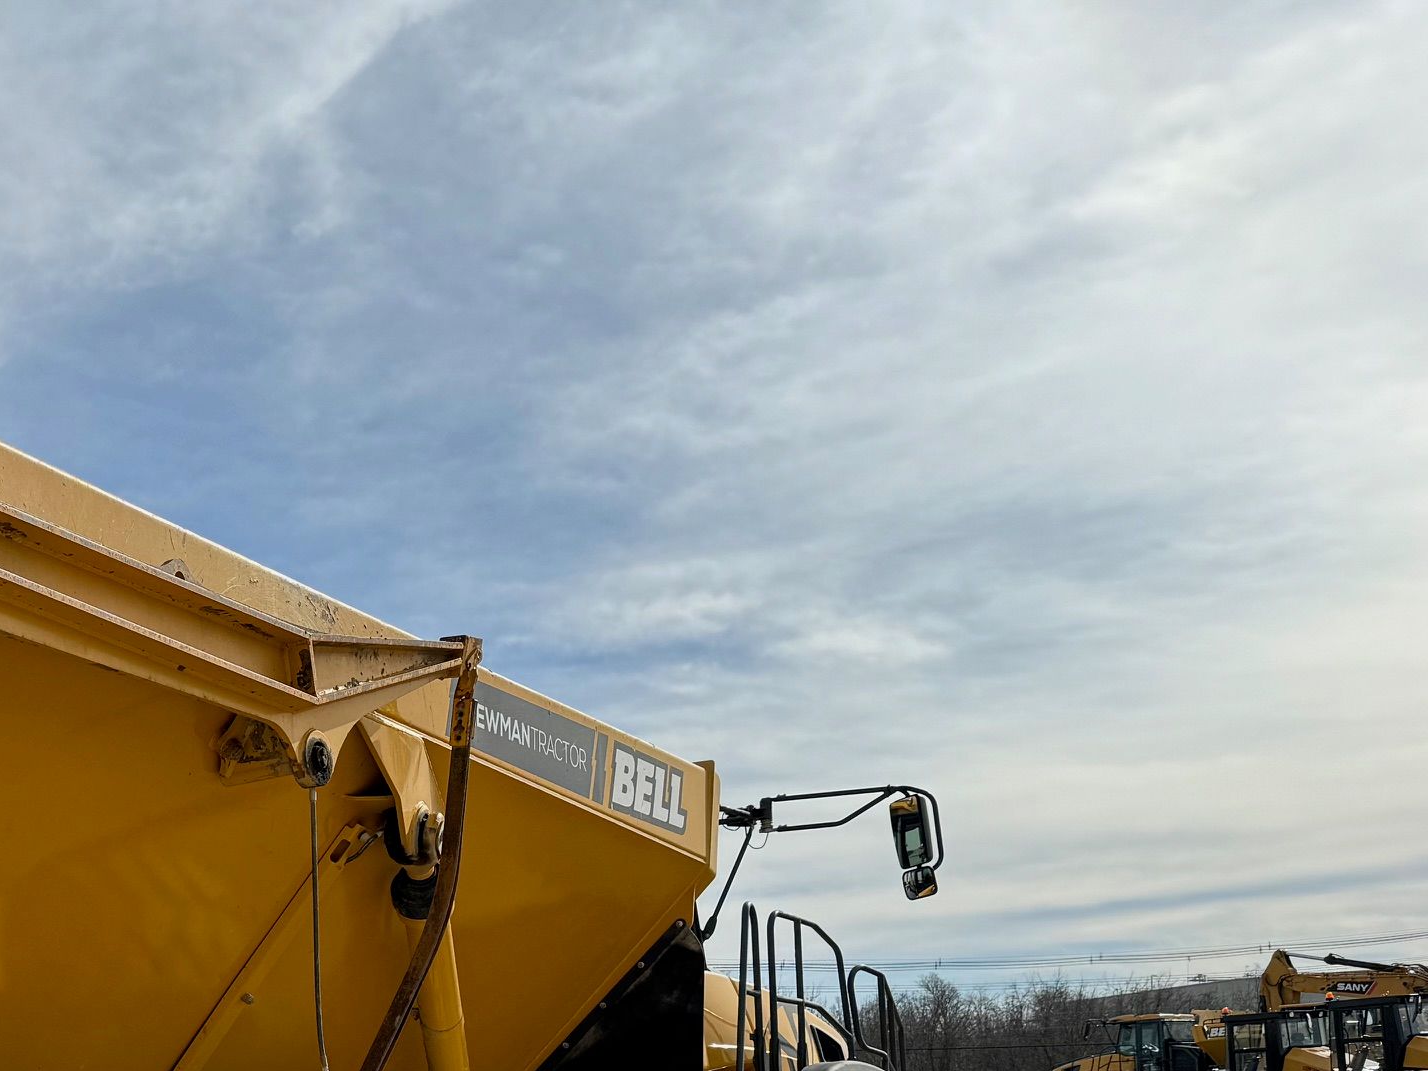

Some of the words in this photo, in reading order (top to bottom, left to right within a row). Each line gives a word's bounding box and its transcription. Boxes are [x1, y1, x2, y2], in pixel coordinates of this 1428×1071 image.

[474, 699, 589, 772] EWMANTRACTOR
[611, 747, 686, 829] BELL
[1336, 982, 1369, 992] SANY
[1209, 1027, 1226, 1038] BE
